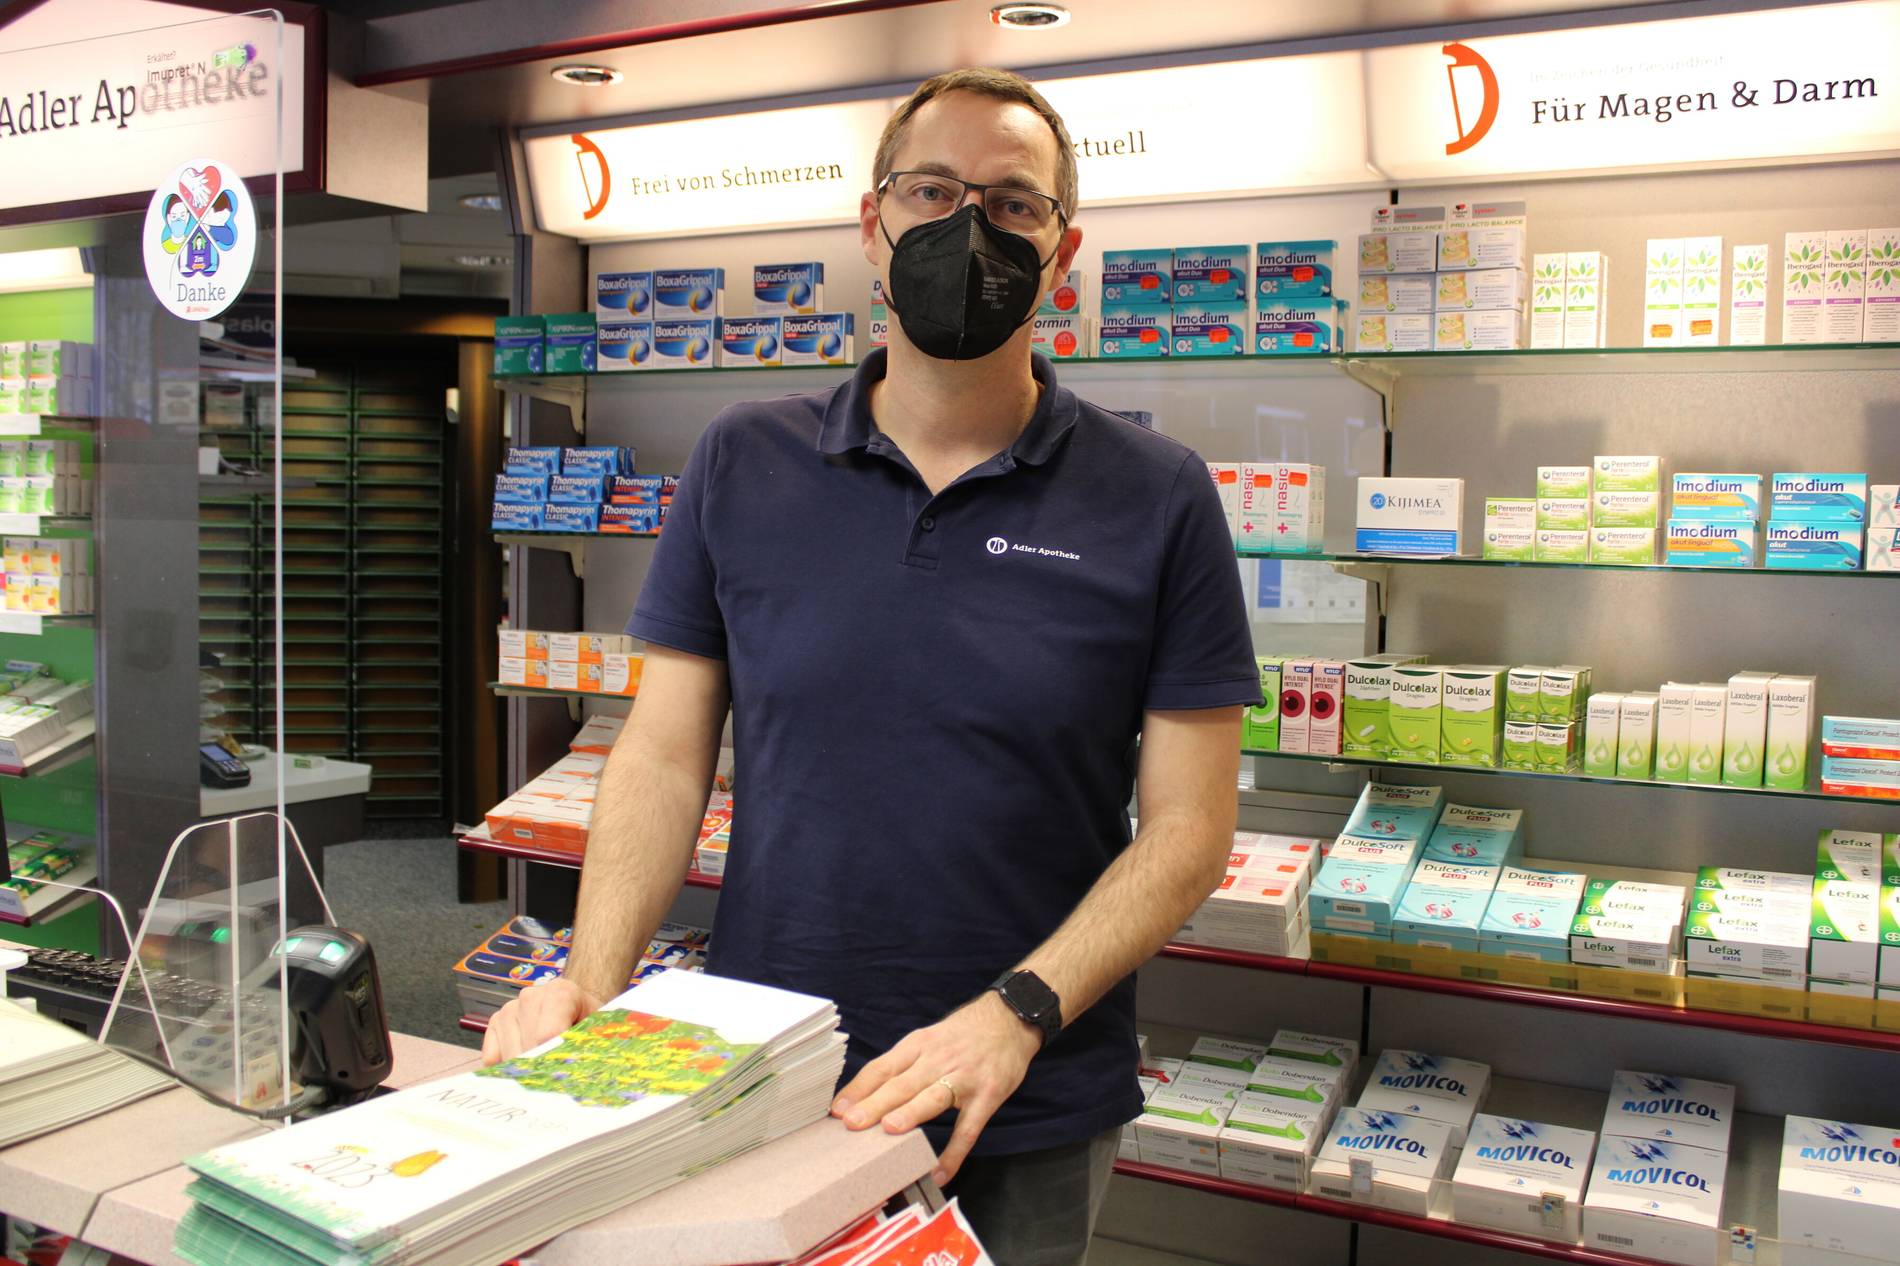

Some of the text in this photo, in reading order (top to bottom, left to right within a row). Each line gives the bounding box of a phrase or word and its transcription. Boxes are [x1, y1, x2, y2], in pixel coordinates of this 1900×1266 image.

[1532, 76, 1879, 124] Für Magen & Darm
[0, 90, 82, 140] Adler
[632, 161, 844, 195] Frei von Schmerzen
[1177, 257, 1232, 269] Imodium
[1259, 253, 1316, 265] Imodium
[1105, 261, 1157, 272] Imodium
[656, 275, 713, 288] BoxaGrippal
[755, 269, 810, 283] BoxaGrippal
[598, 277, 649, 291] BoxaGrippal
[177, 282, 226, 302] Danke
[1103, 315, 1156, 326] Imodium
[1176, 313, 1229, 325] Imodium
[1259, 310, 1316, 322] Imodium
[724, 322, 778, 336] BoxaGrippal
[784, 319, 841, 334] BoxaGrippal
[1034, 319, 1071, 329] ormin
[600, 326, 649, 341] BoxaGrippal
[655, 323, 709, 338] BoxaGrippal
[508, 447, 556, 458] Thomapyrin
[565, 447, 614, 458] Thomapyrin
[496, 474, 545, 486] Thomapyrin
[552, 475, 600, 486] Thomapyrin
[1676, 480, 1742, 492] Imodium
[1775, 479, 1844, 492] Imodium
[1243, 468, 1254, 510] nasic
[1278, 468, 1289, 510] nasic
[494, 503, 542, 514] Thomapyrin
[1388, 496, 1441, 509] KIJIMEA
[545, 504, 595, 515] Thomapyrin
[602, 505, 656, 516] Thomapyrin
[1670, 525, 1737, 538] Imodium
[1769, 527, 1839, 540] Imodium
[1012, 543, 1080, 560] Adler Apotheke
[1347, 674, 1391, 685] Dulcolax
[1510, 679, 1537, 687] Dulcolax
[1542, 681, 1570, 690] Dulcolax
[1393, 682, 1437, 694] Dulcolax
[1445, 685, 1491, 697] Dulcolax
[1662, 697, 1689, 706] Laxoberal
[1730, 691, 1763, 700] Laxoberal
[1772, 693, 1806, 703] Laxoberal
[1693, 699, 1721, 707] Laxoberal
[1590, 707, 1615, 715] Laxoberal
[1624, 708, 1650, 717] Laxoberal
[1507, 728, 1534, 736] Dulcolax
[1538, 729, 1566, 738] Dulcolax
[1370, 785, 1431, 797] DulceSoft
[1450, 807, 1513, 820] DulceSoft
[1341, 838, 1405, 851] DulceSoft
[1833, 837, 1873, 848] Lefax
[1423, 863, 1489, 878] DulceSoft
[1727, 870, 1768, 881] Lefax
[1507, 871, 1577, 886] DulceSoft
[1617, 884, 1648, 893] Lefax
[1828, 888, 1870, 900] Lefax
[1724, 893, 1763, 904] Lefax
[1608, 901, 1645, 912] Lefax
[1596, 919, 1634, 930] Lefax
[1718, 916, 1759, 928] Lefax
[1584, 941, 1615, 953] Lefax
[1708, 944, 1741, 957] Lefax
[1281, 1068, 1326, 1083] Dobendan
[1379, 1073, 1468, 1097] MOVICOL
[425, 1088, 527, 1122] NATUR
[1179, 1092, 1223, 1106] Dobendan
[1262, 1106, 1308, 1120] Dobendan
[1621, 1098, 1721, 1122] MOVICOL
[1336, 1133, 1428, 1159] MOVICOL
[1476, 1145, 1575, 1169] MOVICOL
[1800, 1145, 1900, 1167] MOVICO
[1606, 1167, 1711, 1194] MOVICOL
